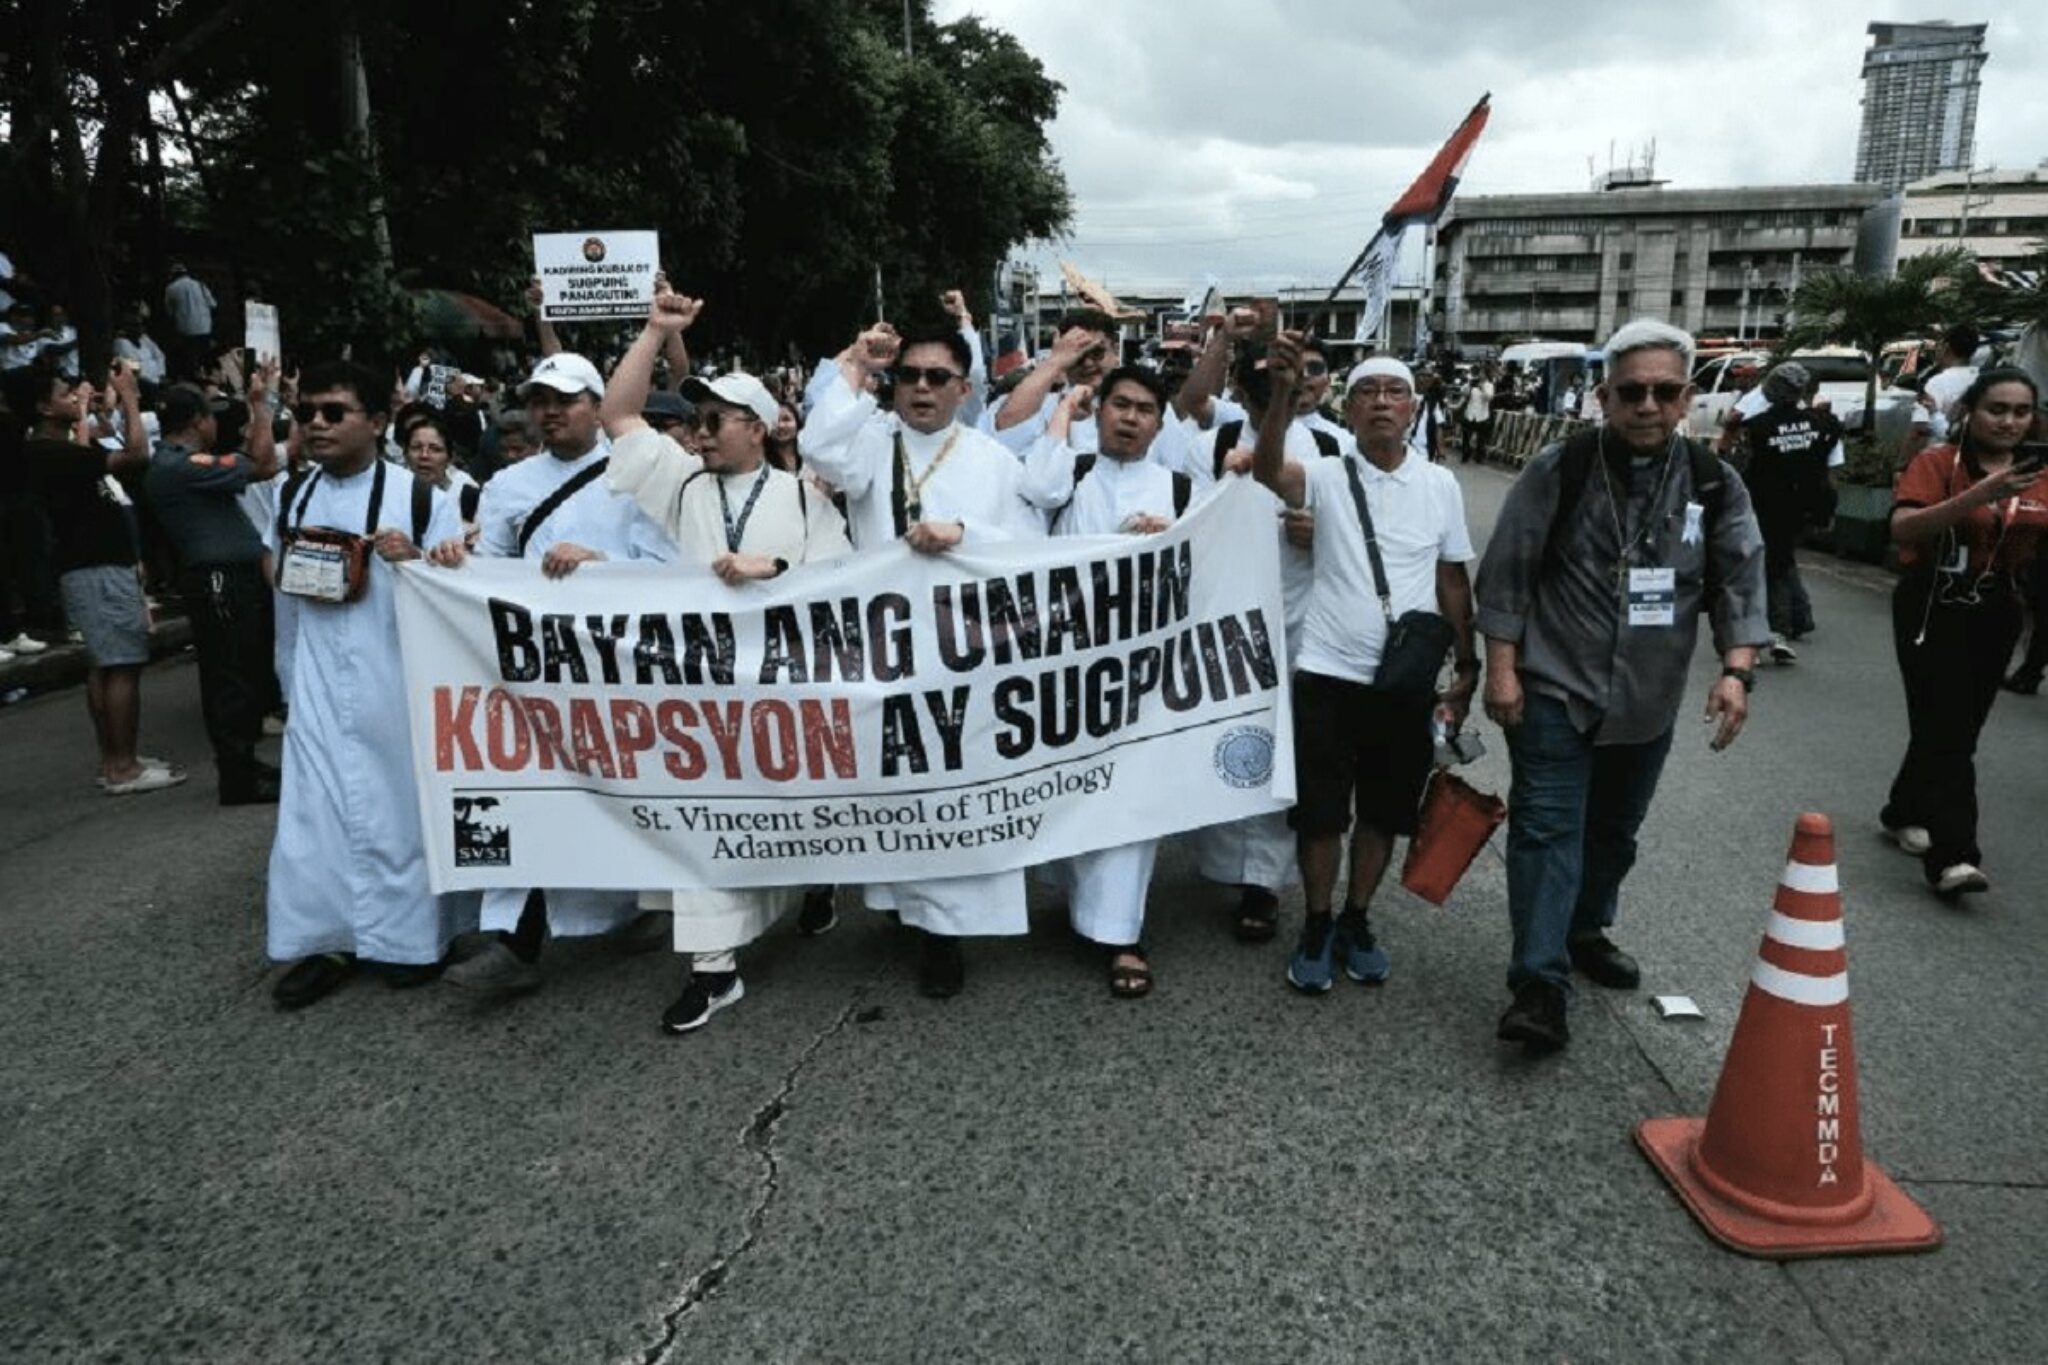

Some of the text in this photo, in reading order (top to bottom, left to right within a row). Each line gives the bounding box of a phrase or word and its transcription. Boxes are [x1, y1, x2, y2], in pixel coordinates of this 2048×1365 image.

[488, 539, 1191, 685] BAYAN ANG UNAHIN
[433, 685, 859, 782] KORAPSYON
[881, 685, 971, 777] AY
[994, 607, 1279, 760] SUGPUIN
[632, 761, 1116, 833] St. Vincent School of Theology
[459, 847, 508, 859] SVST
[711, 812, 1043, 860] Adamson University
